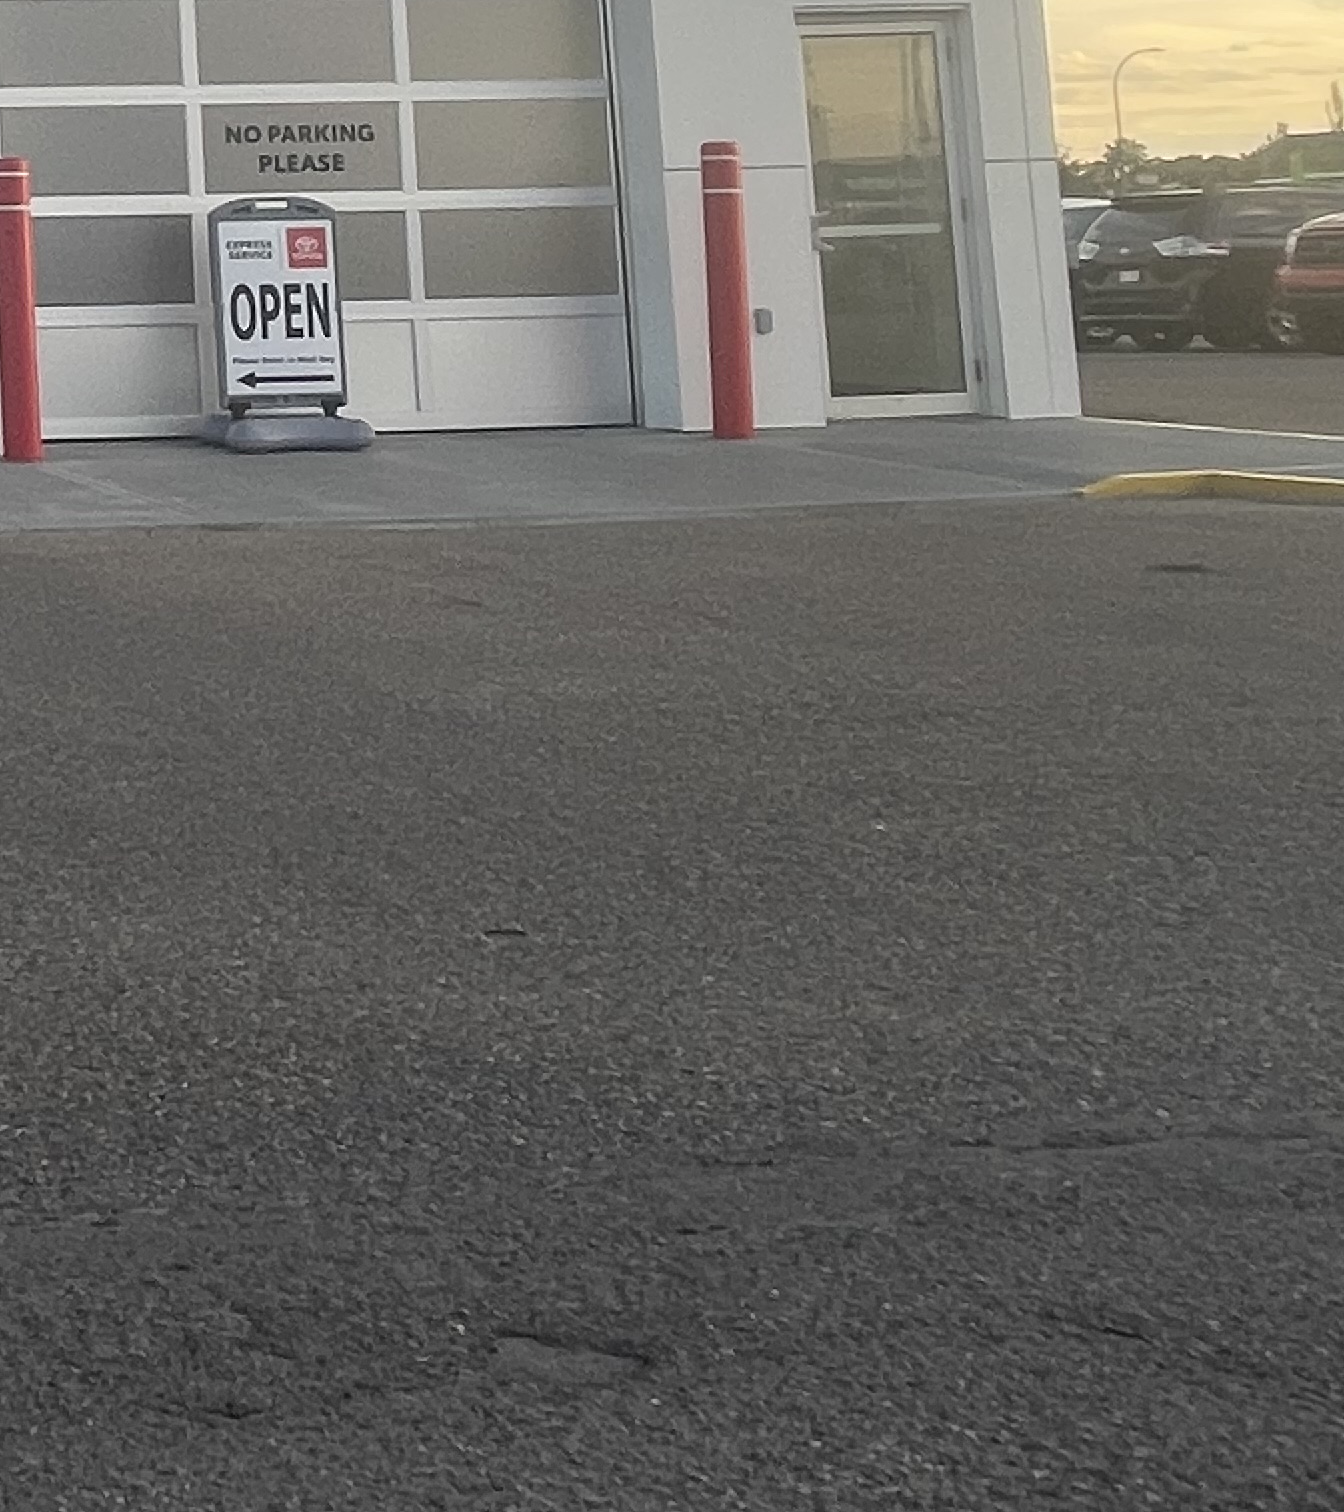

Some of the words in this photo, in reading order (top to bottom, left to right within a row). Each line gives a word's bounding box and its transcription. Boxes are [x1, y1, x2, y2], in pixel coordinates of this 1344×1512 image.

[225, 124, 262, 144] NO
[268, 122, 376, 144] PARKING
[258, 153, 346, 174] PLEASE
[230, 282, 332, 340] OPEN
